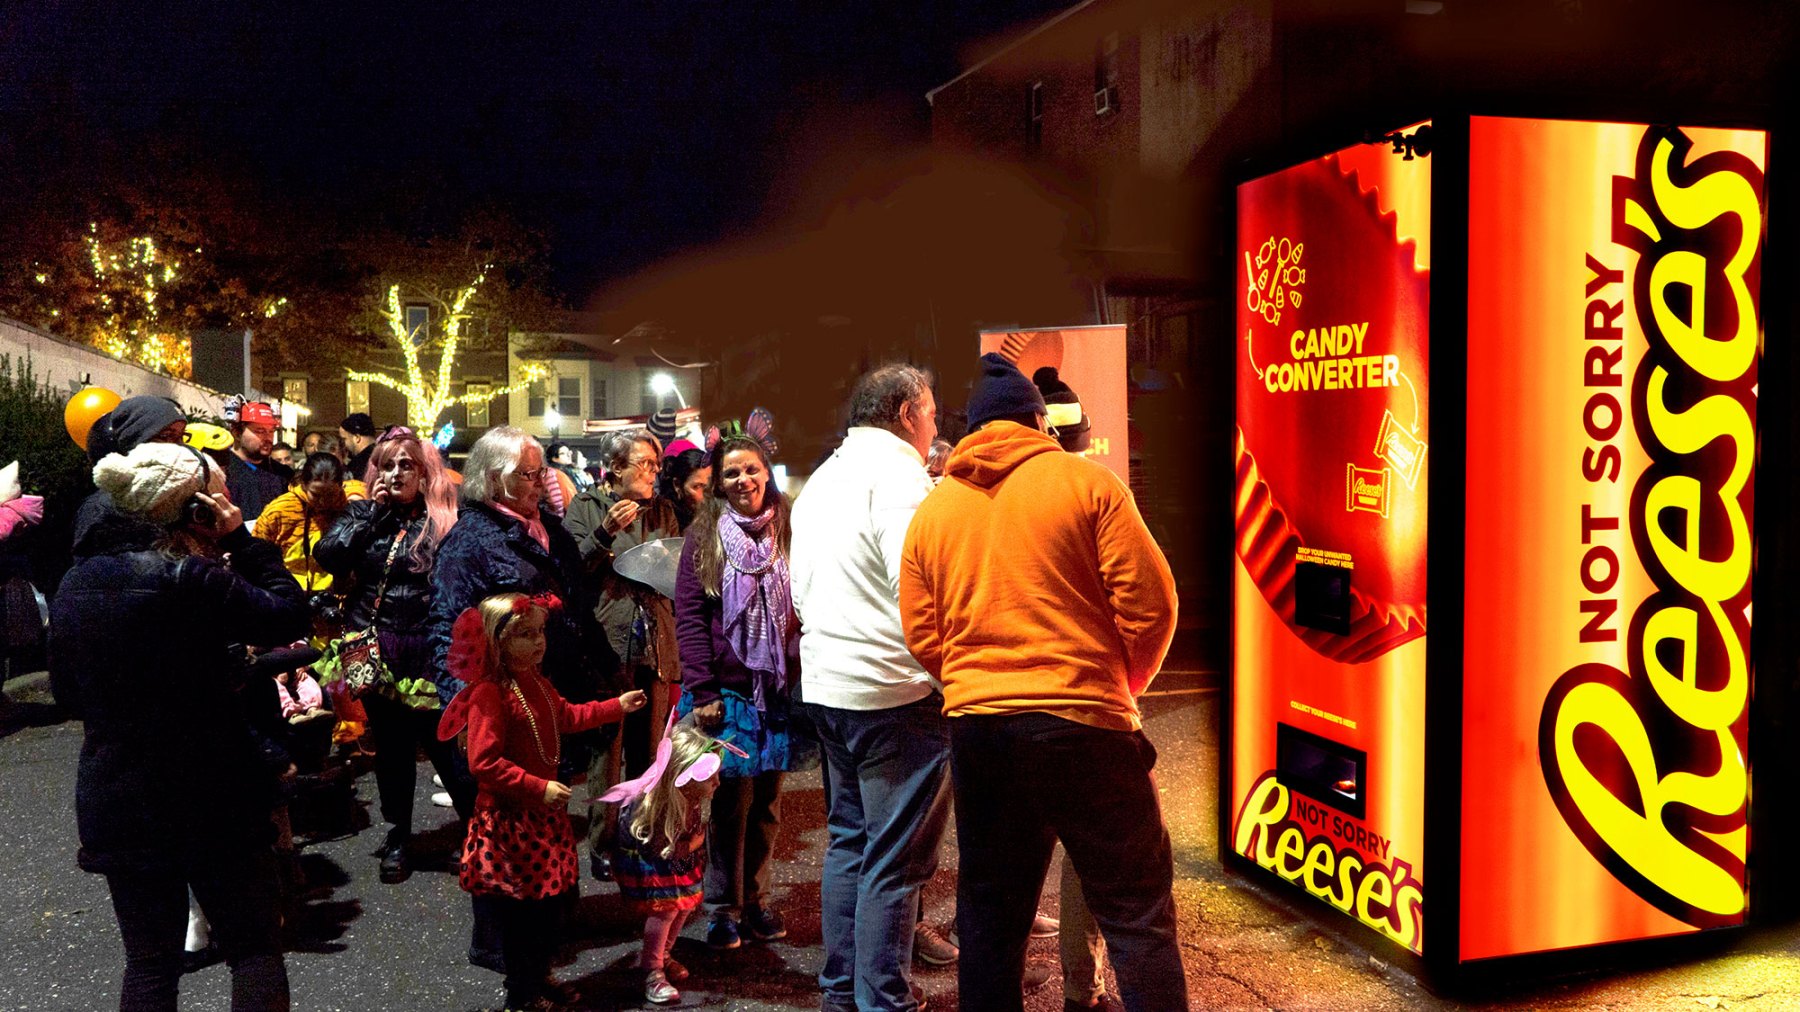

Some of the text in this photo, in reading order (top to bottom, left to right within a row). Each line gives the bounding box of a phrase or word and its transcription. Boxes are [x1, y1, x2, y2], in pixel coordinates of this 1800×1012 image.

[1290, 322, 1369, 360] CANDY
[1265, 354, 1400, 393] CONVERTER
[1579, 252, 1624, 643] NOT SORRY
[1555, 136, 1761, 916] Reese's
[1295, 553, 1355, 570] HALLOWEEN CANDY HERE
[1324, 550, 1352, 561] UNWANTED
[1295, 798, 1392, 860] NOT SORRY
[1235, 776, 1424, 950] Reese's
